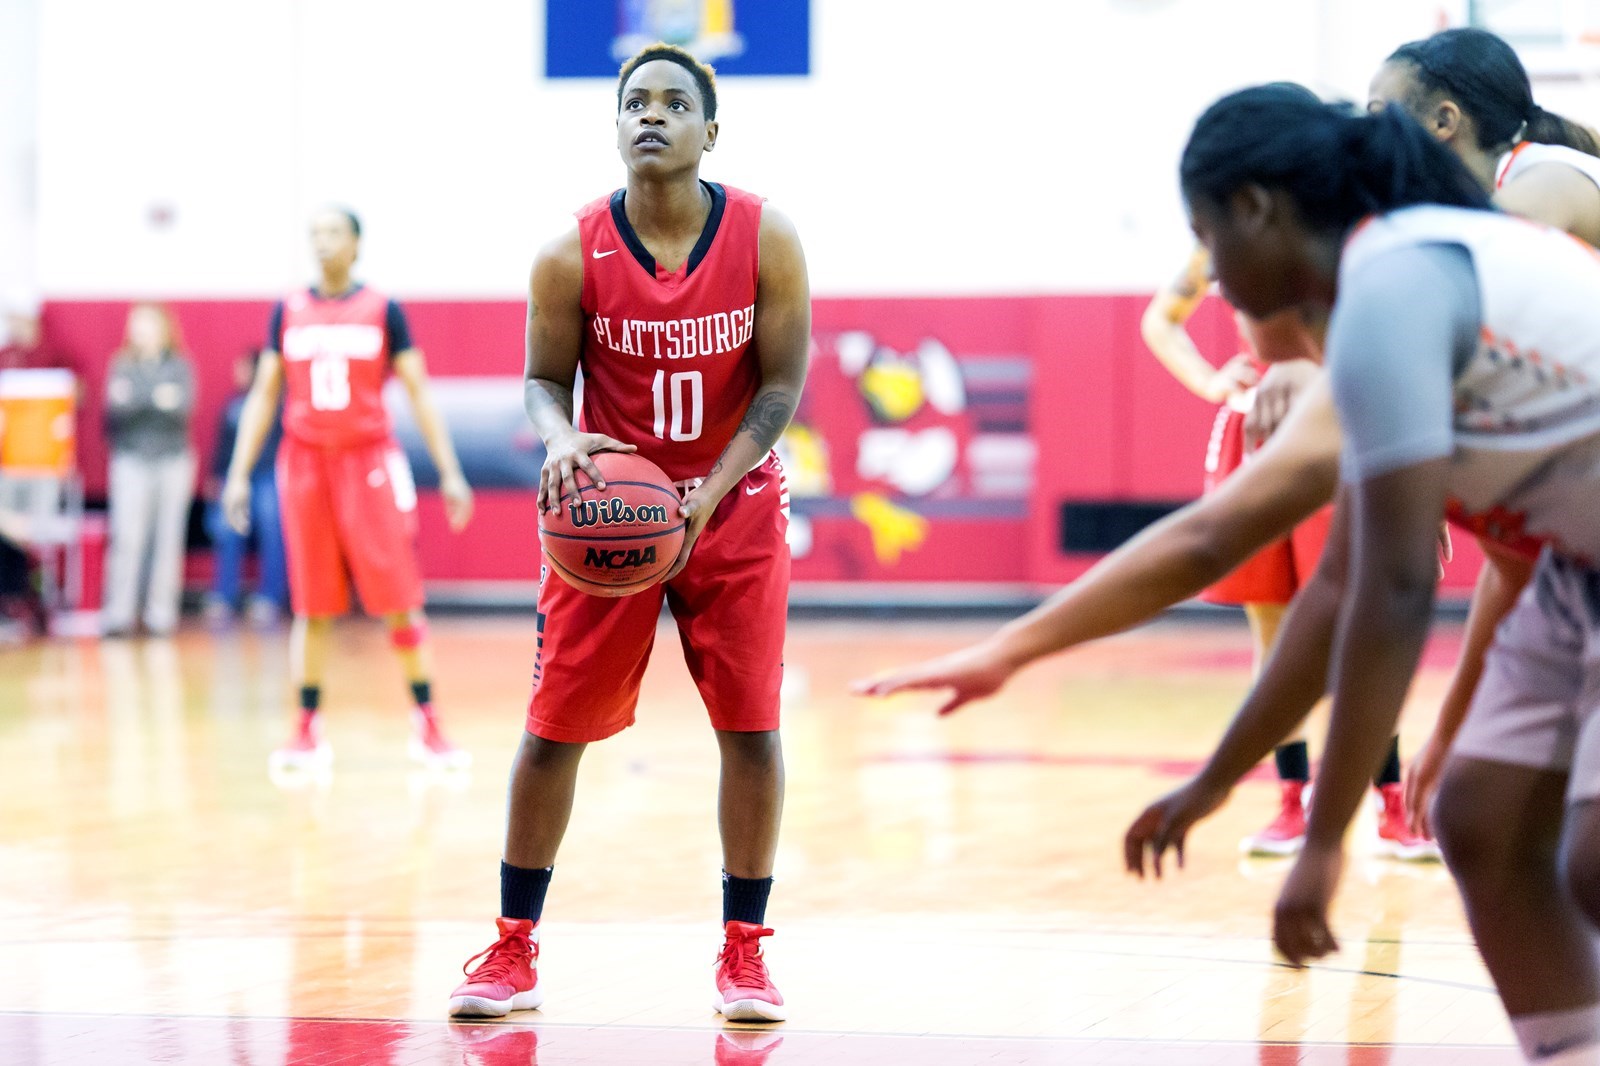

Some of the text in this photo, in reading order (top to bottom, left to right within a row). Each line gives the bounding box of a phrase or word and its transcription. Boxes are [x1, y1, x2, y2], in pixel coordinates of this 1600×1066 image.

[593, 304, 755, 359] PLATTSBURGH
[651, 369, 703, 442] 10
[568, 497, 668, 528] Wilson
[584, 545, 656, 569] NCAA
